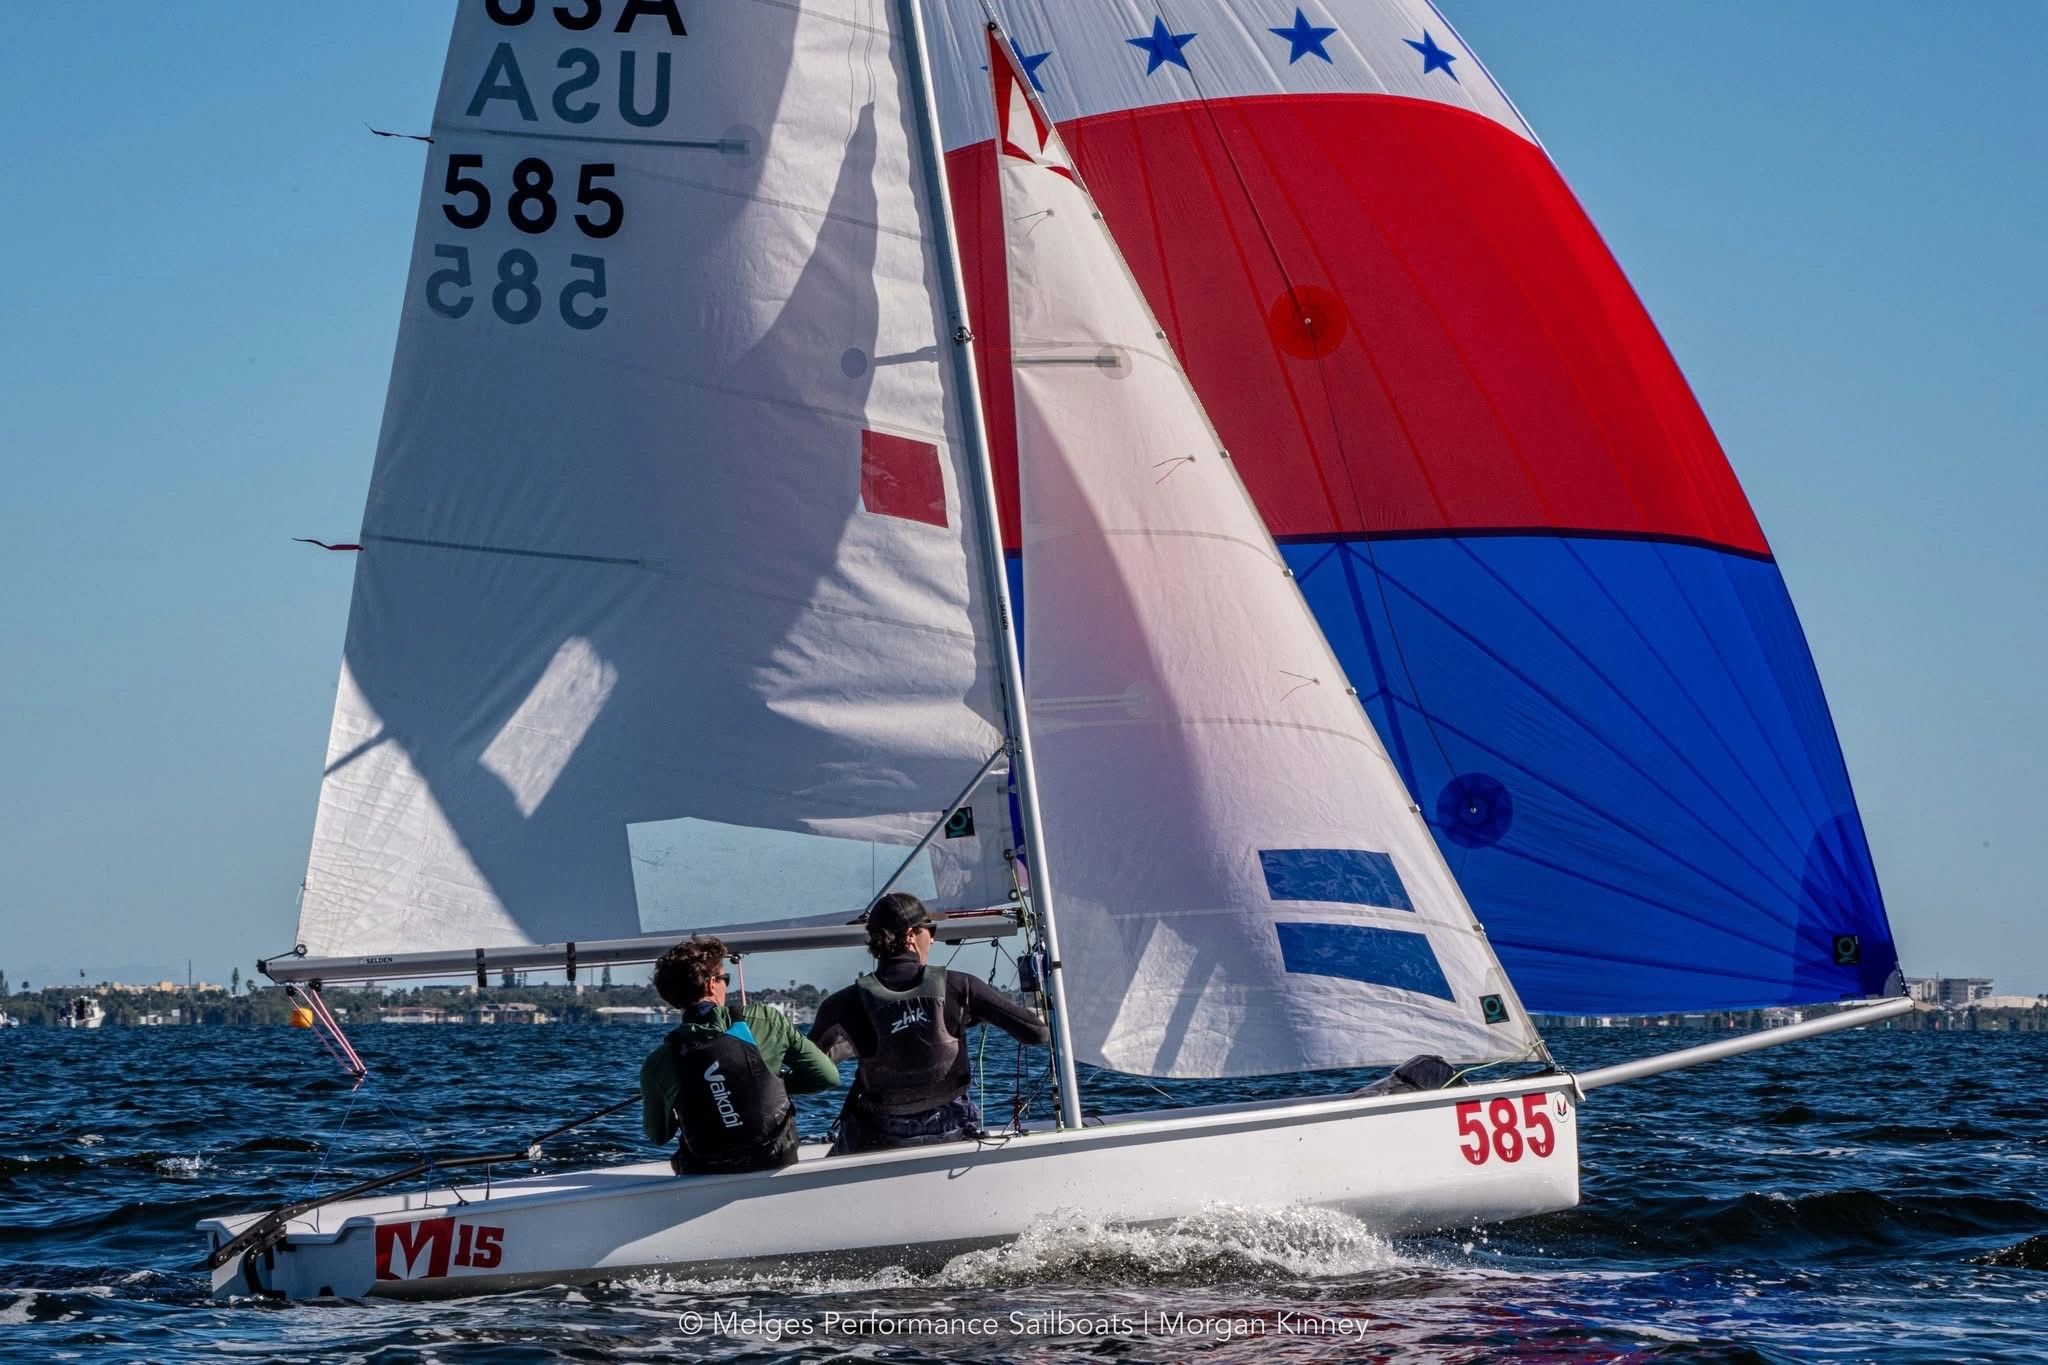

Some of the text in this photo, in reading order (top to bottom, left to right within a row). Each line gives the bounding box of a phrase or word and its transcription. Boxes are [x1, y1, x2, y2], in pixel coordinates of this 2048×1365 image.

[442, 154, 624, 239] 585
[891, 1007, 928, 1034] zhik
[704, 1060, 743, 1128] Vaikobi
[1456, 1092, 1555, 1166] 585
